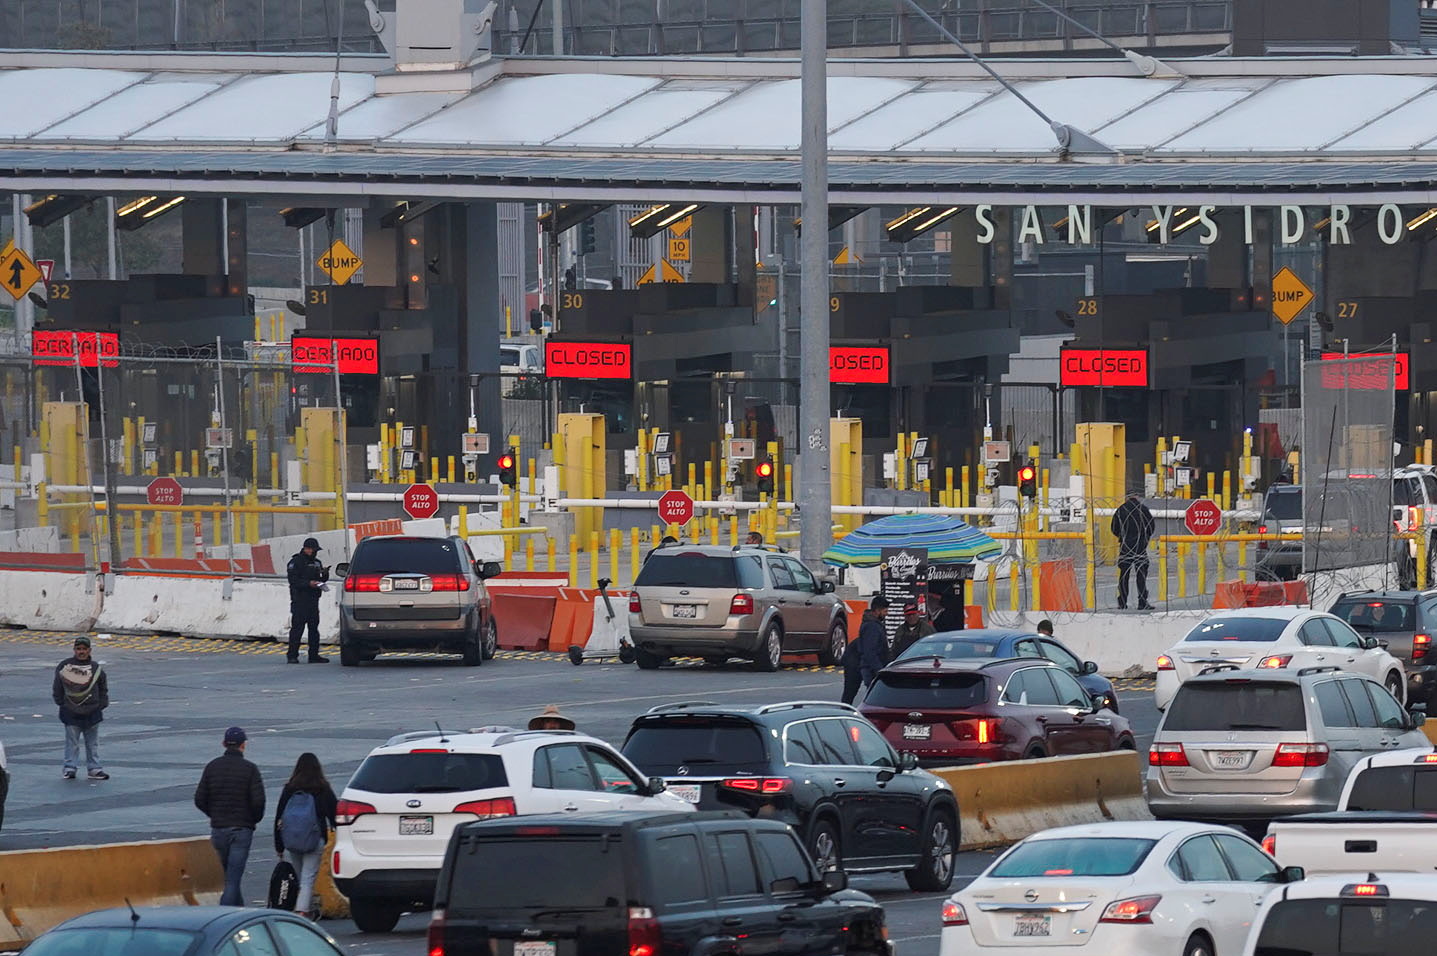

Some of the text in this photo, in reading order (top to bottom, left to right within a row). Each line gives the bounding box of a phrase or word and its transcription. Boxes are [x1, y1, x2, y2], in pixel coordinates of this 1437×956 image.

[975, 204, 1091, 245] SAN
[1154, 203, 1402, 245] YSIDRO
[322, 257, 359, 269] BUMP
[50, 284, 71, 300] 32
[309, 290, 328, 305] 31
[563, 293, 583, 310] 30
[830, 297, 840, 312] 9
[1077, 299, 1098, 316] 28
[1338, 302, 1358, 318] 27
[550, 350, 627, 366] CLOSED
[829, 355, 884, 370] OSED
[1065, 357, 1142, 373] CLOSED
[666, 500, 685, 508] STOP
[667, 508, 686, 516] ALTO
[1193, 510, 1213, 518] STOP
[1193, 517, 1214, 526] ALTO
